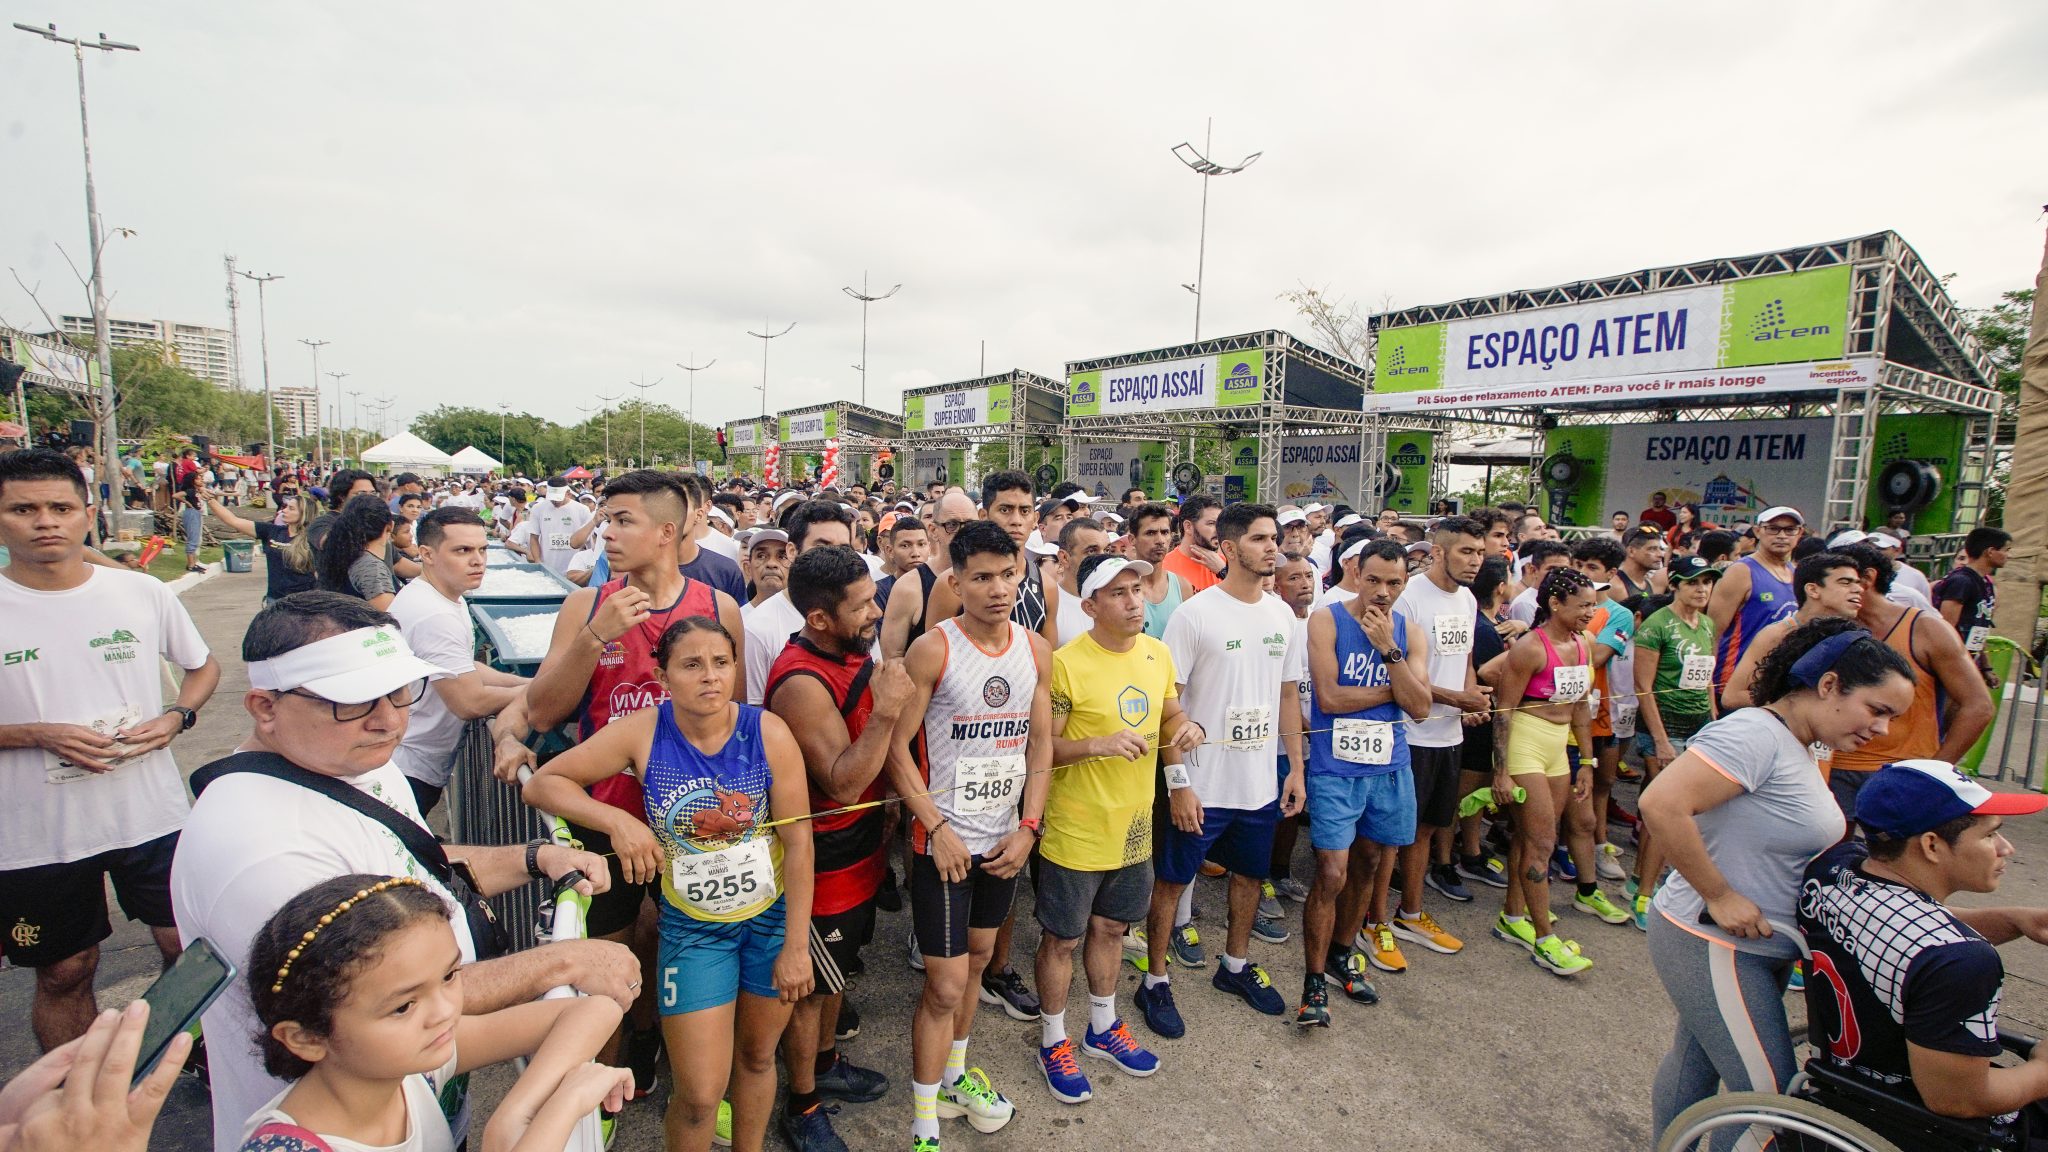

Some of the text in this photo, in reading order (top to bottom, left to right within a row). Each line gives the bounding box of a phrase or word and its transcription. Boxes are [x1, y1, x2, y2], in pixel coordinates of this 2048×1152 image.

[1467, 308, 1688, 371] ESPAÇO ATEM
[1754, 325, 1830, 342] atem
[1388, 365, 1429, 376] atem
[1809, 369, 1858, 378] incentivo
[1109, 364, 1205, 404] ESPAÇO ASSAÍ
[1826, 375, 1868, 384] esporte
[1417, 374, 1766, 405] Pit Stop de relaxamento ATEM: Para você ir mais longe
[944, 392, 966, 409] ESPAÇO
[934, 410, 952, 426] SUPER
[953, 407, 976, 424] ENSINO
[1089, 448, 1113, 462] ESPAÇO
[1282, 441, 1362, 467] ESPAÇO ASSAÍ
[1646, 434, 1806, 465] ESPAÇO ATEM
[1079, 463, 1124, 476] SUPER ENSINO
[1229, 483, 1241, 491] Deu
[1226, 639, 1242, 651] 5K
[1441, 630, 1467, 645] 5206
[4, 648, 41, 666] 5K
[104, 650, 136, 662] MANAUS
[1298, 680, 1313, 694] 60
[1560, 681, 1584, 695] 5205
[951, 719, 1029, 740] MUCURAS
[1232, 723, 1269, 740] 6115
[1340, 736, 1382, 753] 5318
[657, 777, 713, 818] ESPORTE
[964, 779, 1013, 801] 5488
[687, 870, 757, 902] 5255
[824, 934, 844, 943] adidas
[664, 967, 678, 1007] 5
